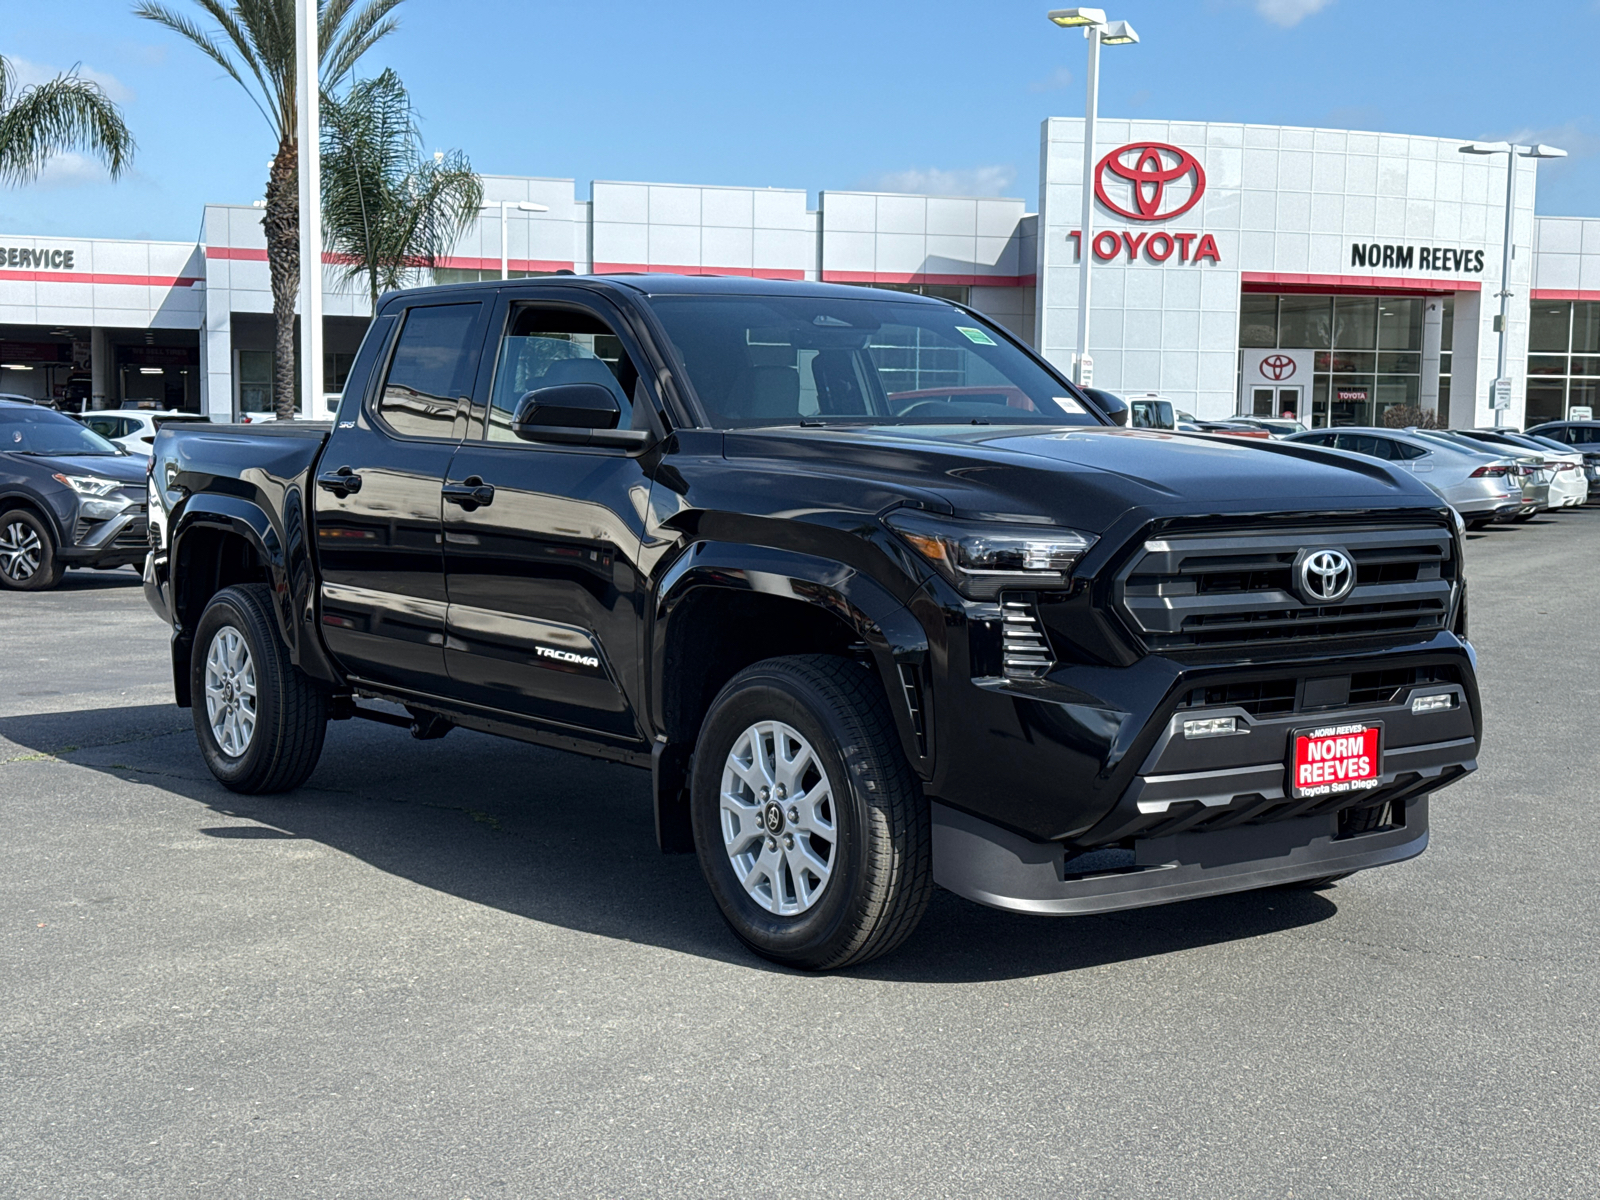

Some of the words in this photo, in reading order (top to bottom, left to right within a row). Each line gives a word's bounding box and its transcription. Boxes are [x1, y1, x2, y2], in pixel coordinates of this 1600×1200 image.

[0, 247, 75, 270] SERVICE
[1351, 243, 1414, 270] NORM
[1419, 246, 1485, 274] REEVES
[535, 645, 599, 668] TACOMA
[1314, 727, 1336, 738] NORM
[1336, 724, 1363, 736] REEVES
[1308, 736, 1364, 762] NORM
[1299, 756, 1370, 784] REEVES
[1300, 785, 1330, 797] Toyota
[1331, 782, 1349, 792] San
[1351, 778, 1378, 789] Diego
